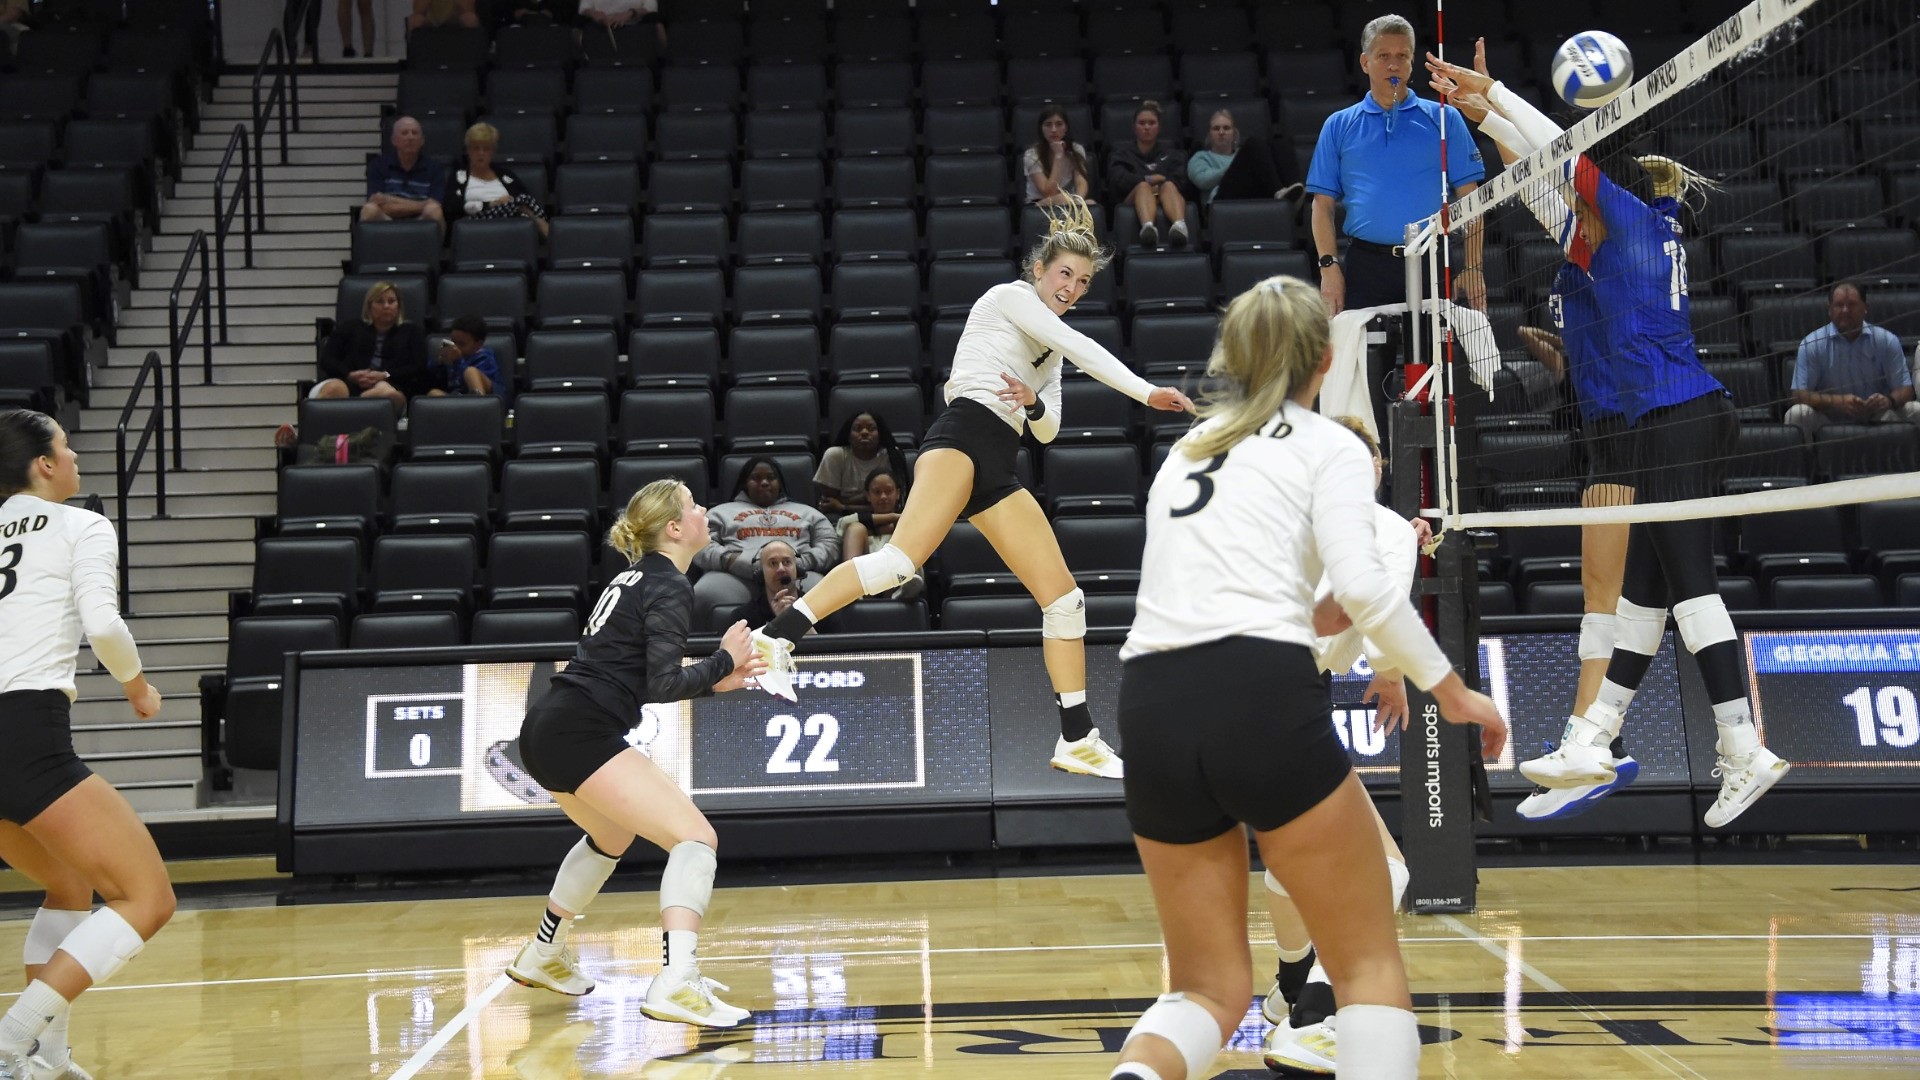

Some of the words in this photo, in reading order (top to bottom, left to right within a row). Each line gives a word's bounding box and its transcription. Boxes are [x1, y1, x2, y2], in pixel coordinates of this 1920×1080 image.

[1170, 448, 1231, 518] 3
[736, 526, 802, 541] UNIVERSITY
[1774, 643, 1892, 662] GEORGIA
[393, 705, 445, 720] SETS
[1422, 704, 1441, 759] sports
[1842, 685, 1920, 748] 19
[409, 733, 431, 767] 0
[765, 713, 840, 774] 22
[1424, 761, 1444, 828] imports
[1415, 898, 1431, 906] (800)
